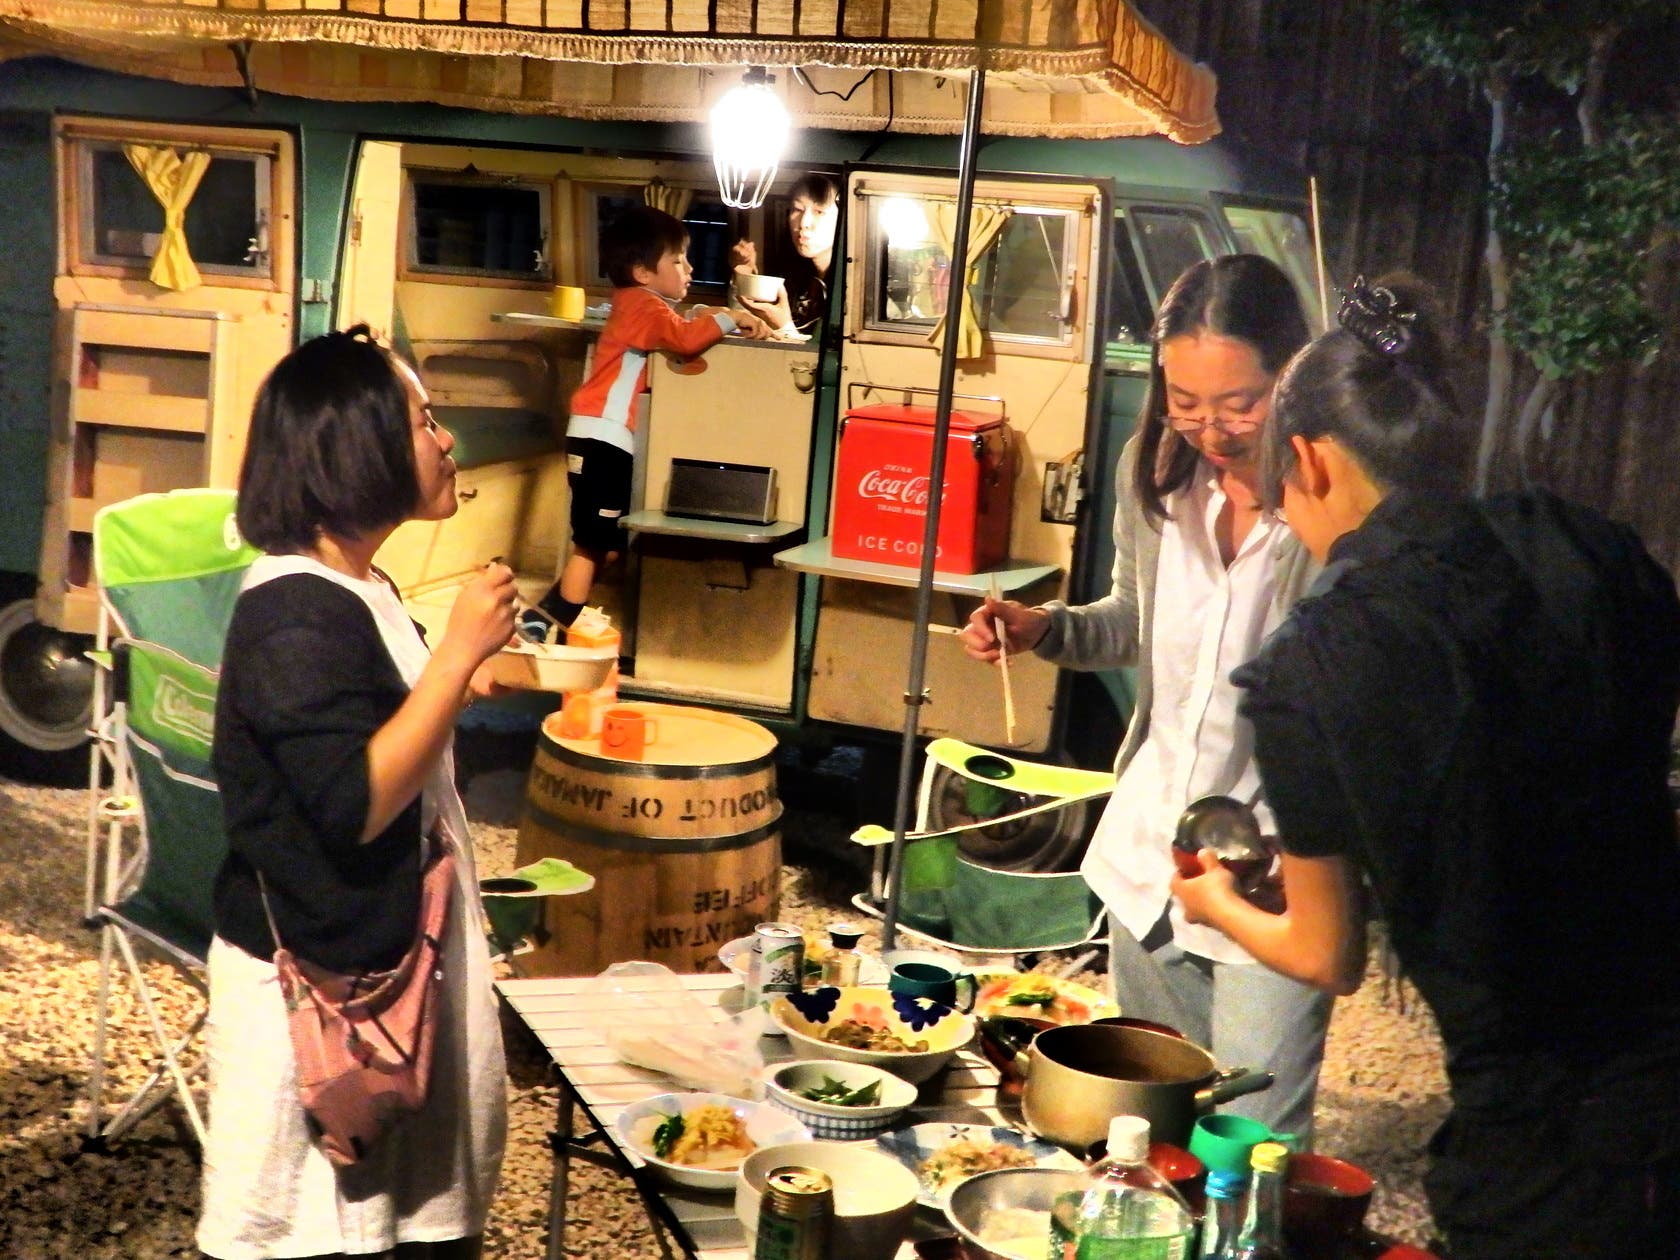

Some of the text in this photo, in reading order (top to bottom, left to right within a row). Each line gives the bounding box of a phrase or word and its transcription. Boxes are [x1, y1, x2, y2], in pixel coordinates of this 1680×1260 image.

[858, 469, 952, 506] Coca-Co
[857, 535, 944, 558] ICE COD
[620, 796, 664, 820] OF
